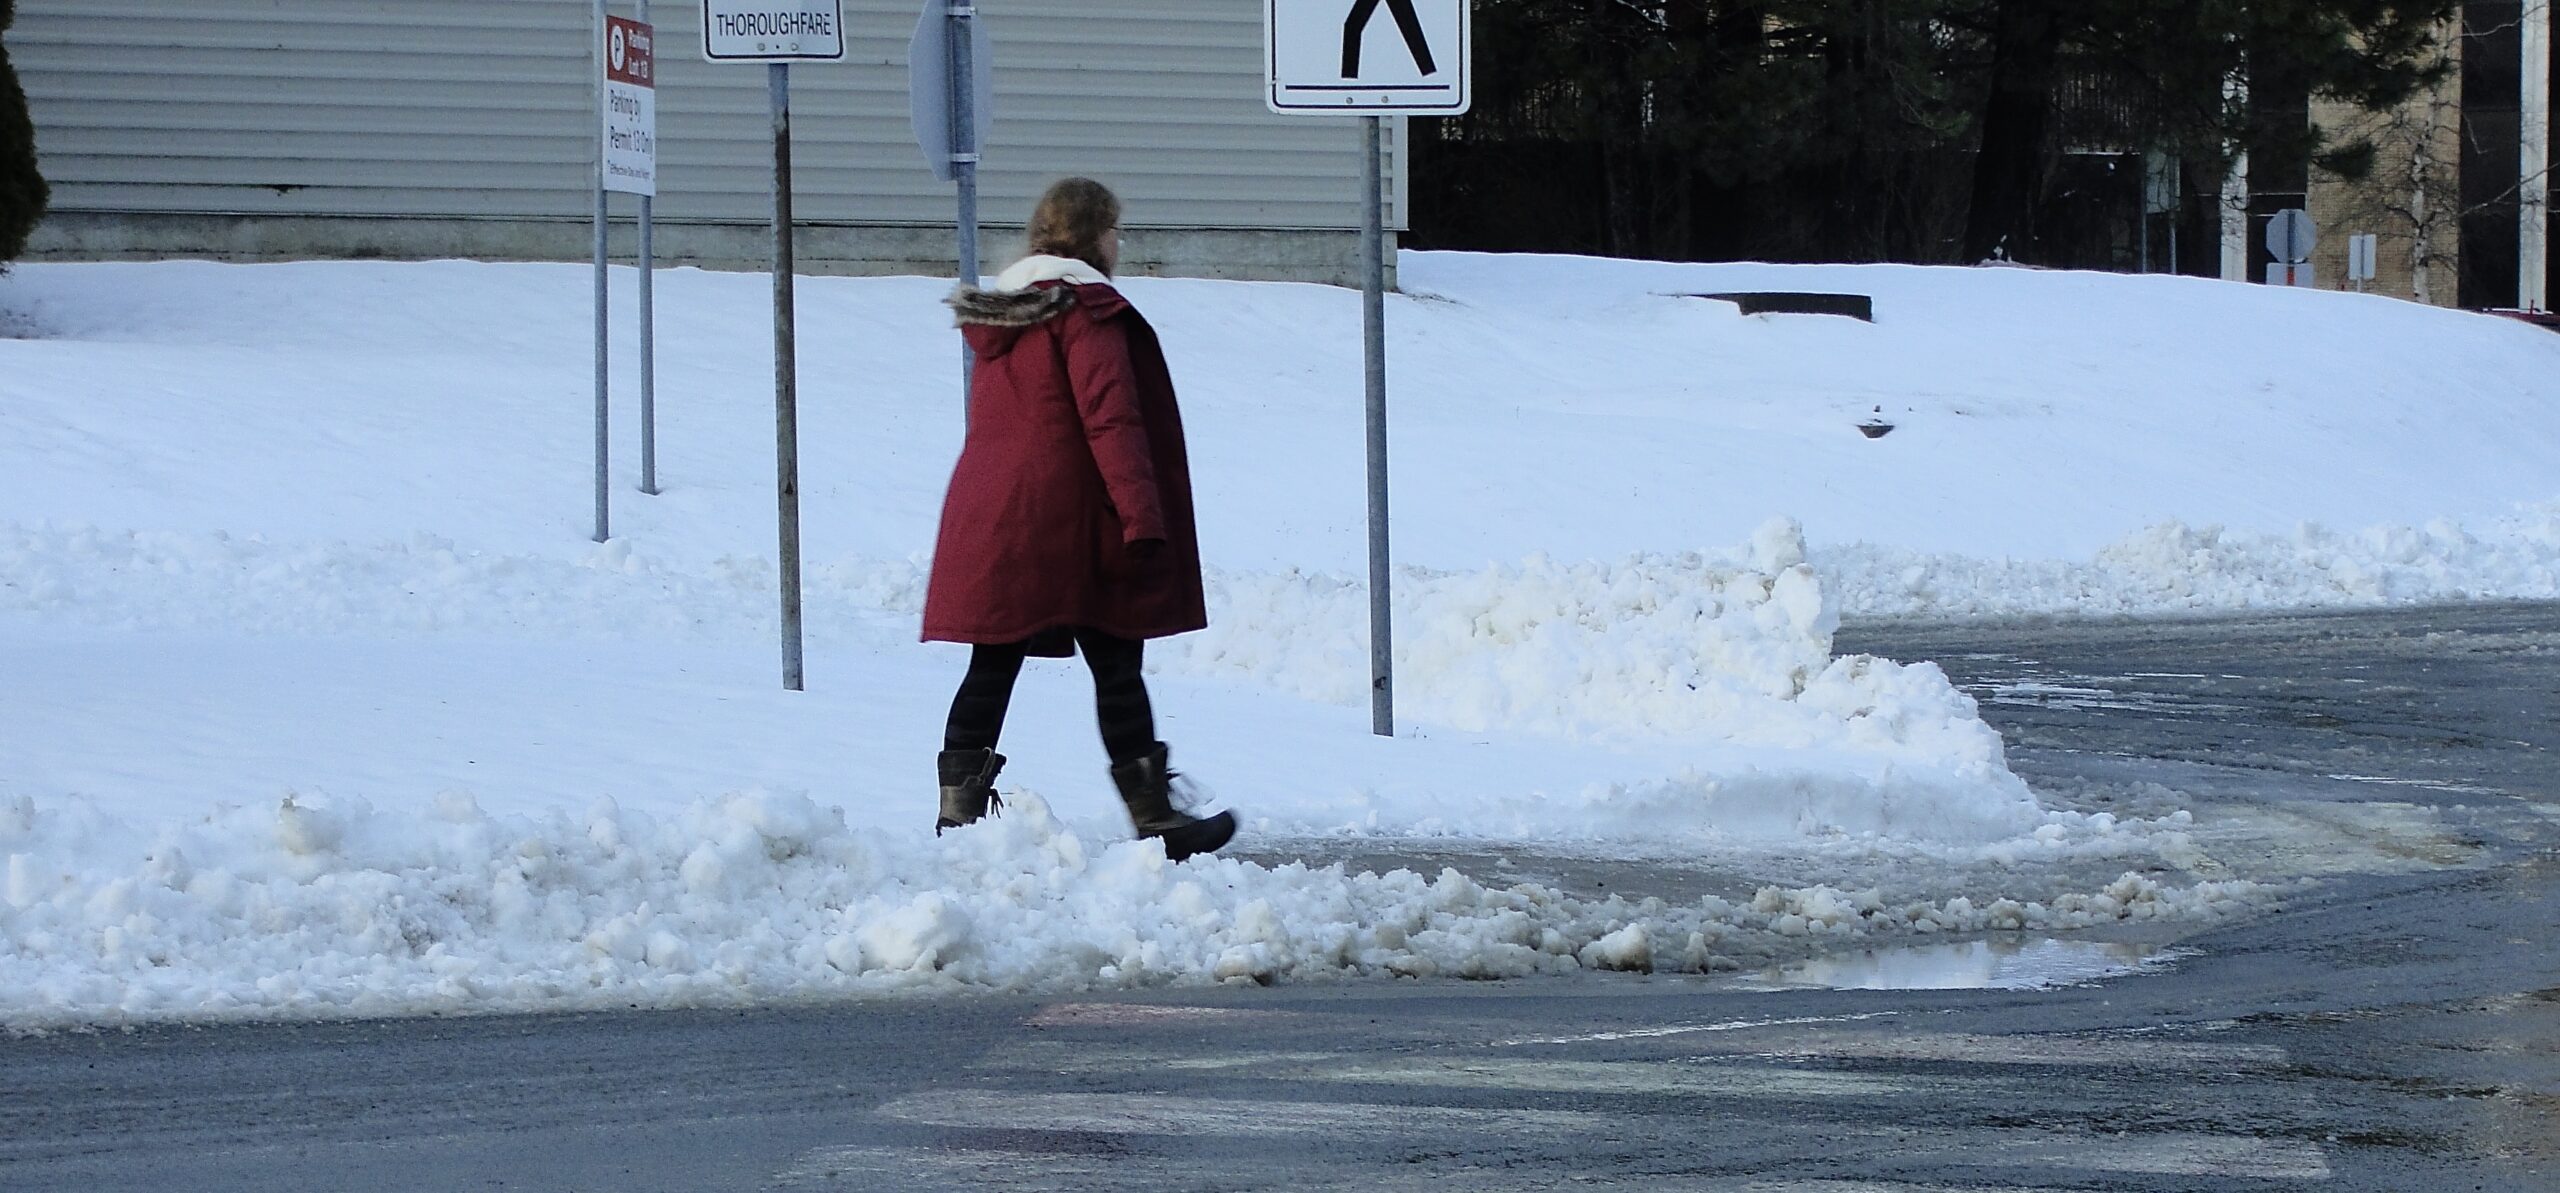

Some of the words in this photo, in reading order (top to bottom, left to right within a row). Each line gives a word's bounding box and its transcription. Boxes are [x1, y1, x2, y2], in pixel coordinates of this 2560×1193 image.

[716, 12, 832, 36] THOROUGHFARE
[614, 34, 621, 62] P
[628, 28, 650, 56] Parking
[628, 56, 639, 77] Lot
[610, 89, 633, 122] Parking
[610, 125, 632, 152] Permit
